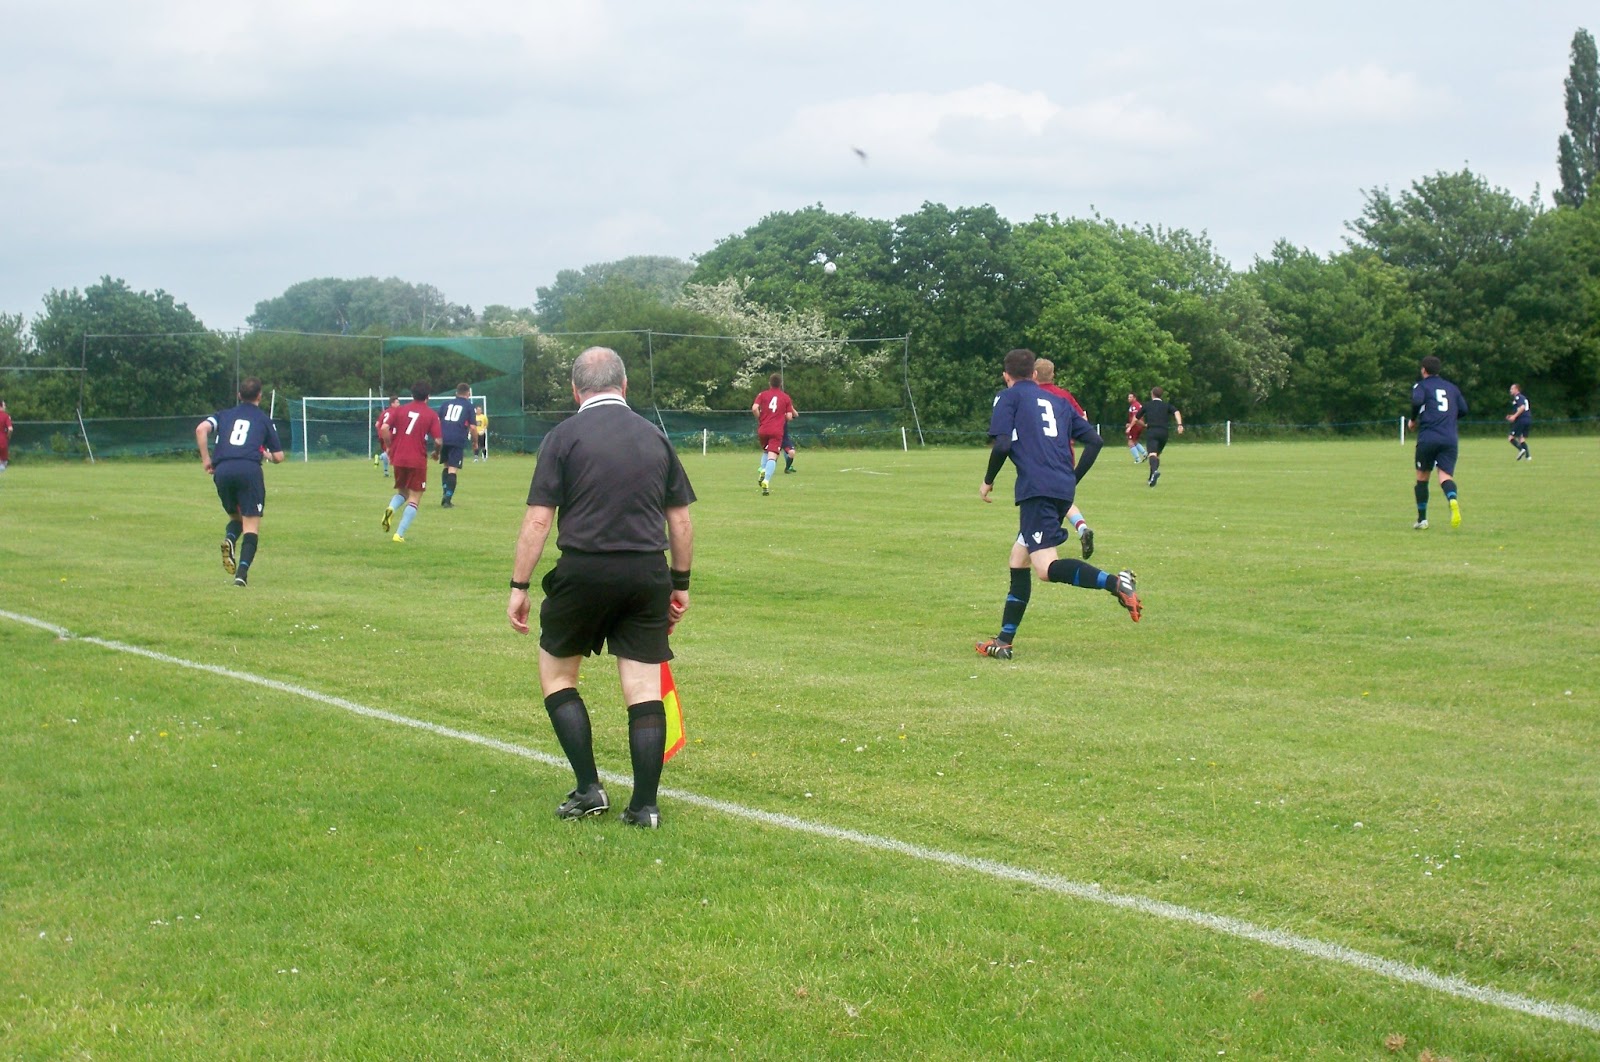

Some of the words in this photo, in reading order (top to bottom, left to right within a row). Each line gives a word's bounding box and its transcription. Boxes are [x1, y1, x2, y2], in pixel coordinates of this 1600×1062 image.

[769, 396, 778, 413] 4
[1436, 389, 1448, 411] 5
[405, 411, 420, 435] 7
[444, 404, 463, 421] 10
[1037, 398, 1058, 437] 3
[230, 419, 250, 446] 8
